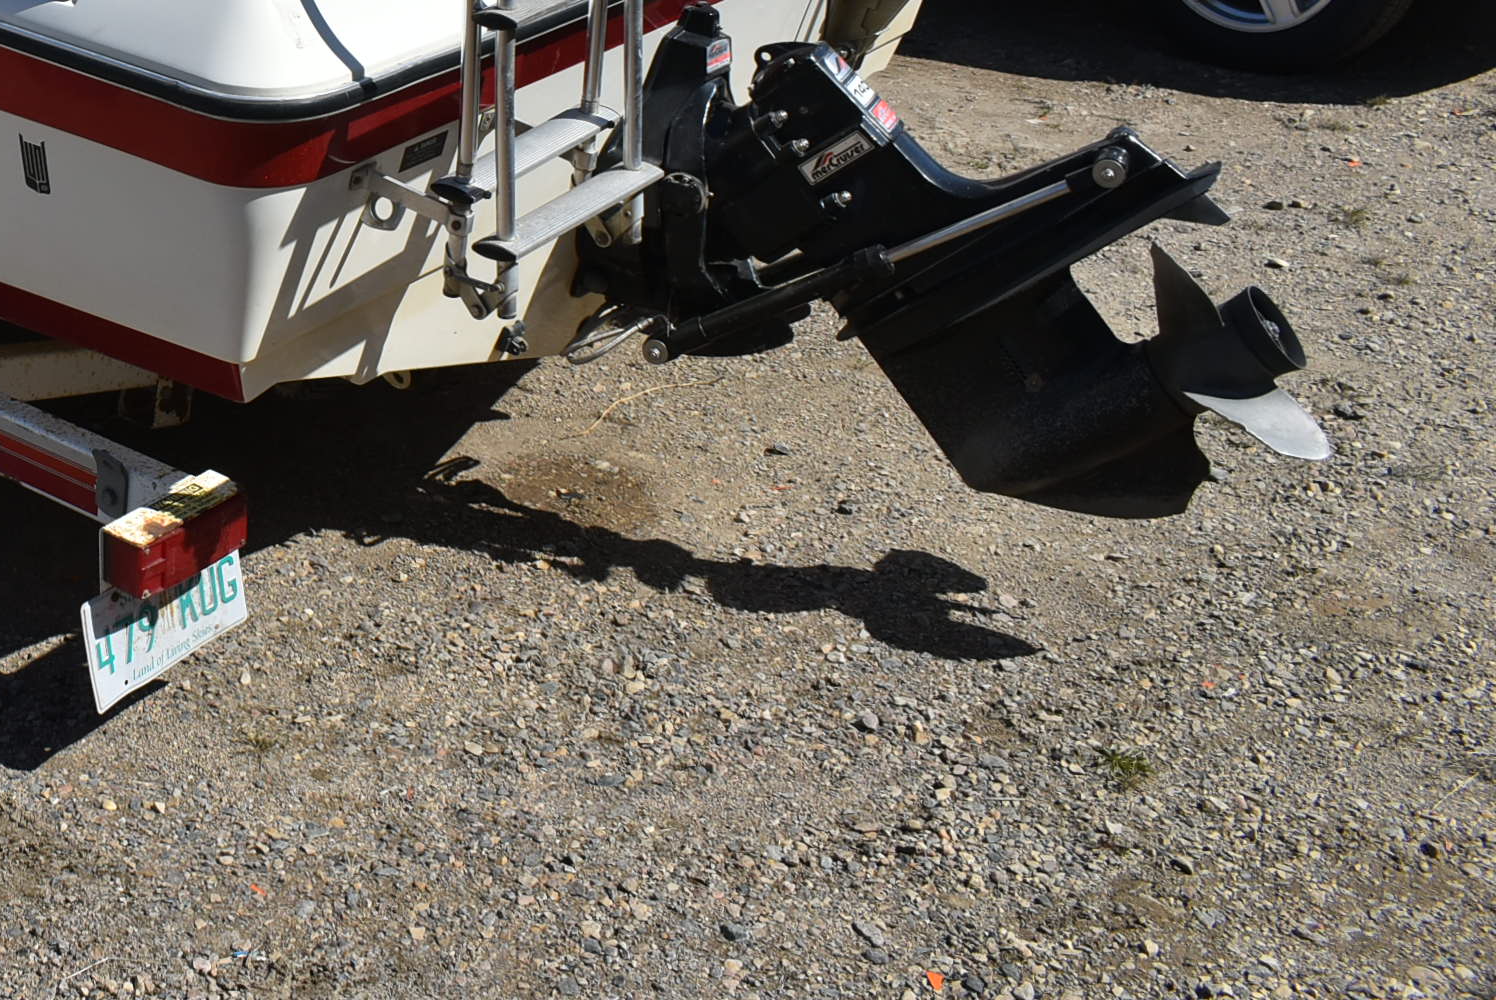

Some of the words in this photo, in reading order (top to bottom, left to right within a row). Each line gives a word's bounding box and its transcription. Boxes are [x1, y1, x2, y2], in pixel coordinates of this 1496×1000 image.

[95, 602, 160, 675] 479
[178, 555, 238, 630] KUG
[132, 654, 154, 681] Land
[156, 651, 166, 666] of
[166, 637, 192, 660] Living
